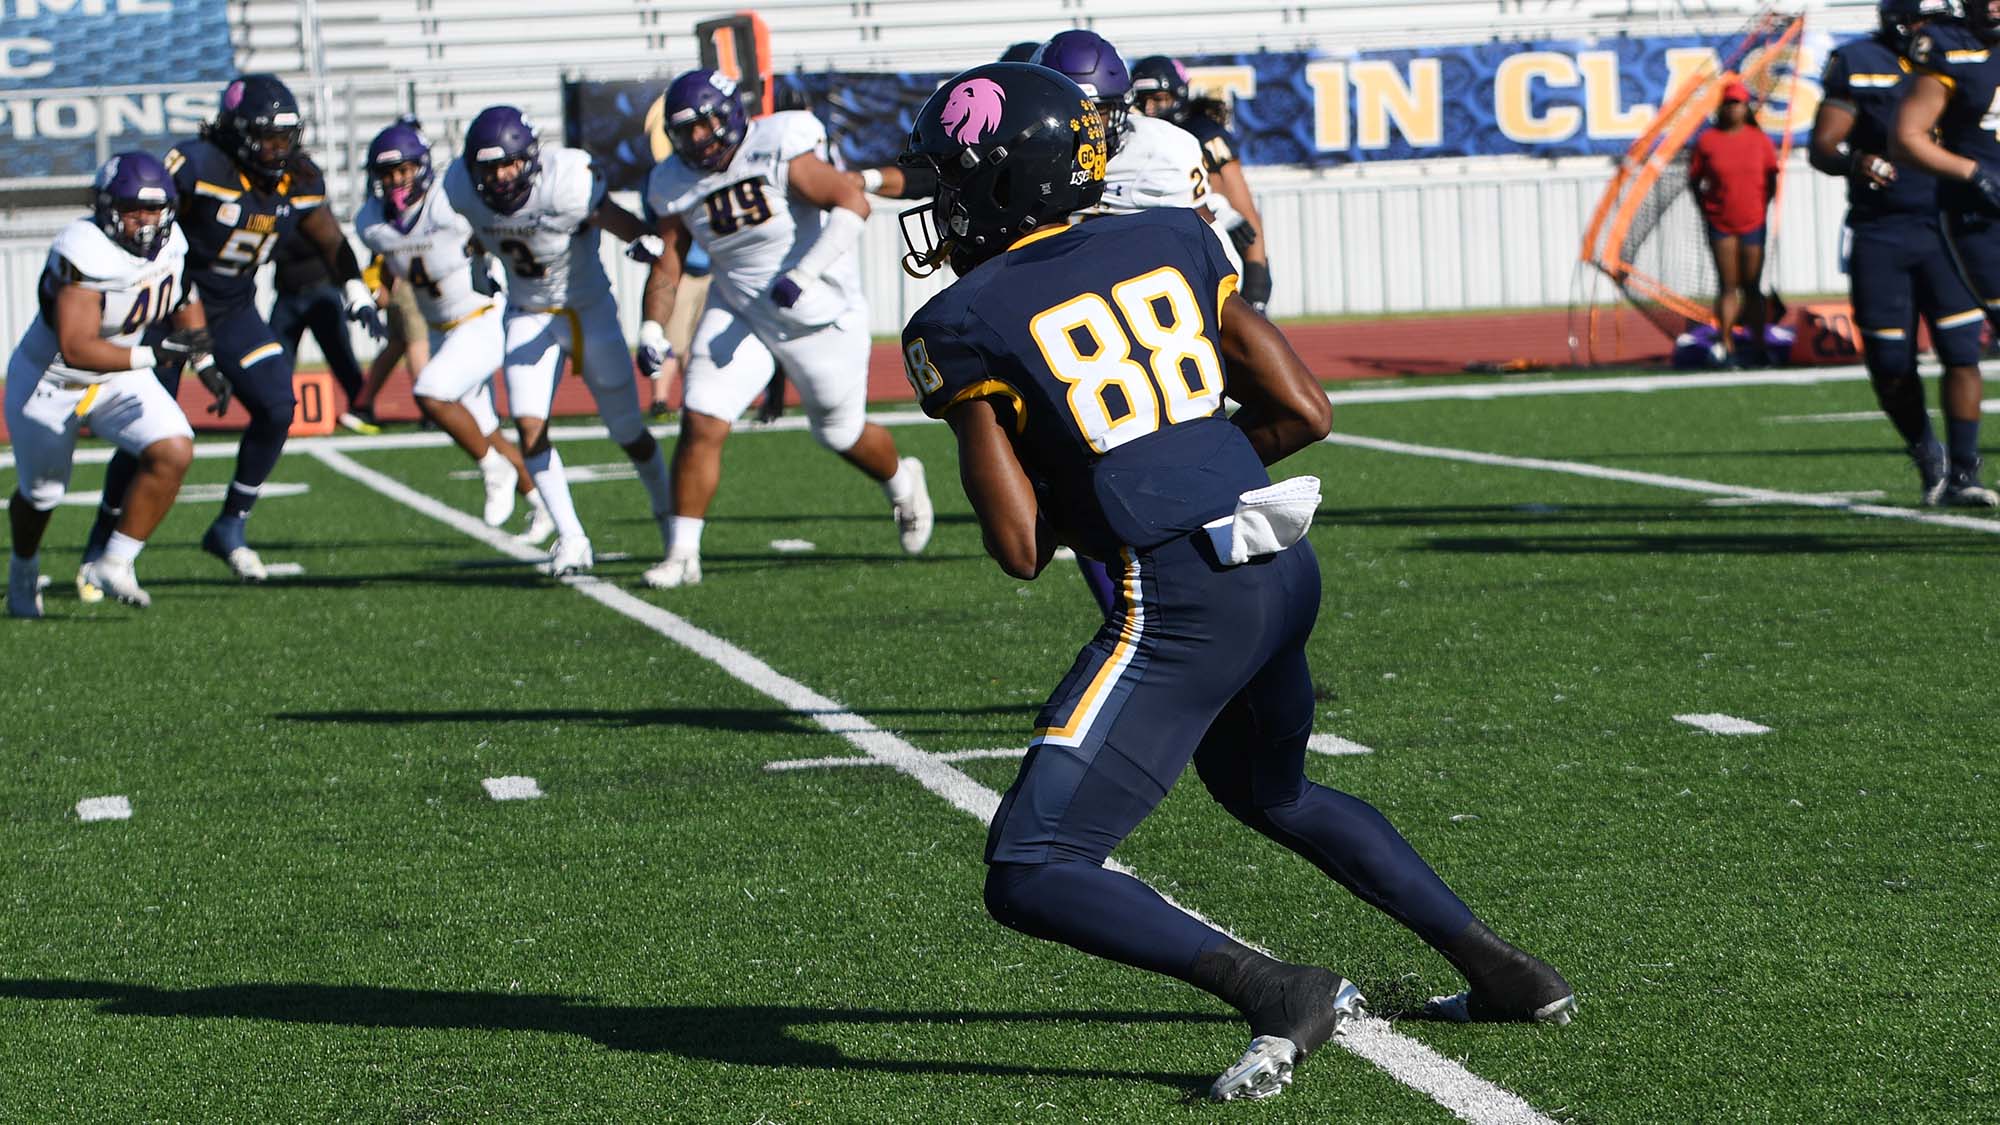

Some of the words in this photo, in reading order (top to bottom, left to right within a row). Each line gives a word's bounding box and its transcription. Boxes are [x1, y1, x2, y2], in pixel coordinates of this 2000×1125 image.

[712, 26, 743, 81] 1
[0, 91, 221, 140] IONS
[1306, 58, 1444, 152] IN
[409, 256, 442, 297] 4
[499, 238, 546, 278] 3
[1029, 266, 1224, 454] 88
